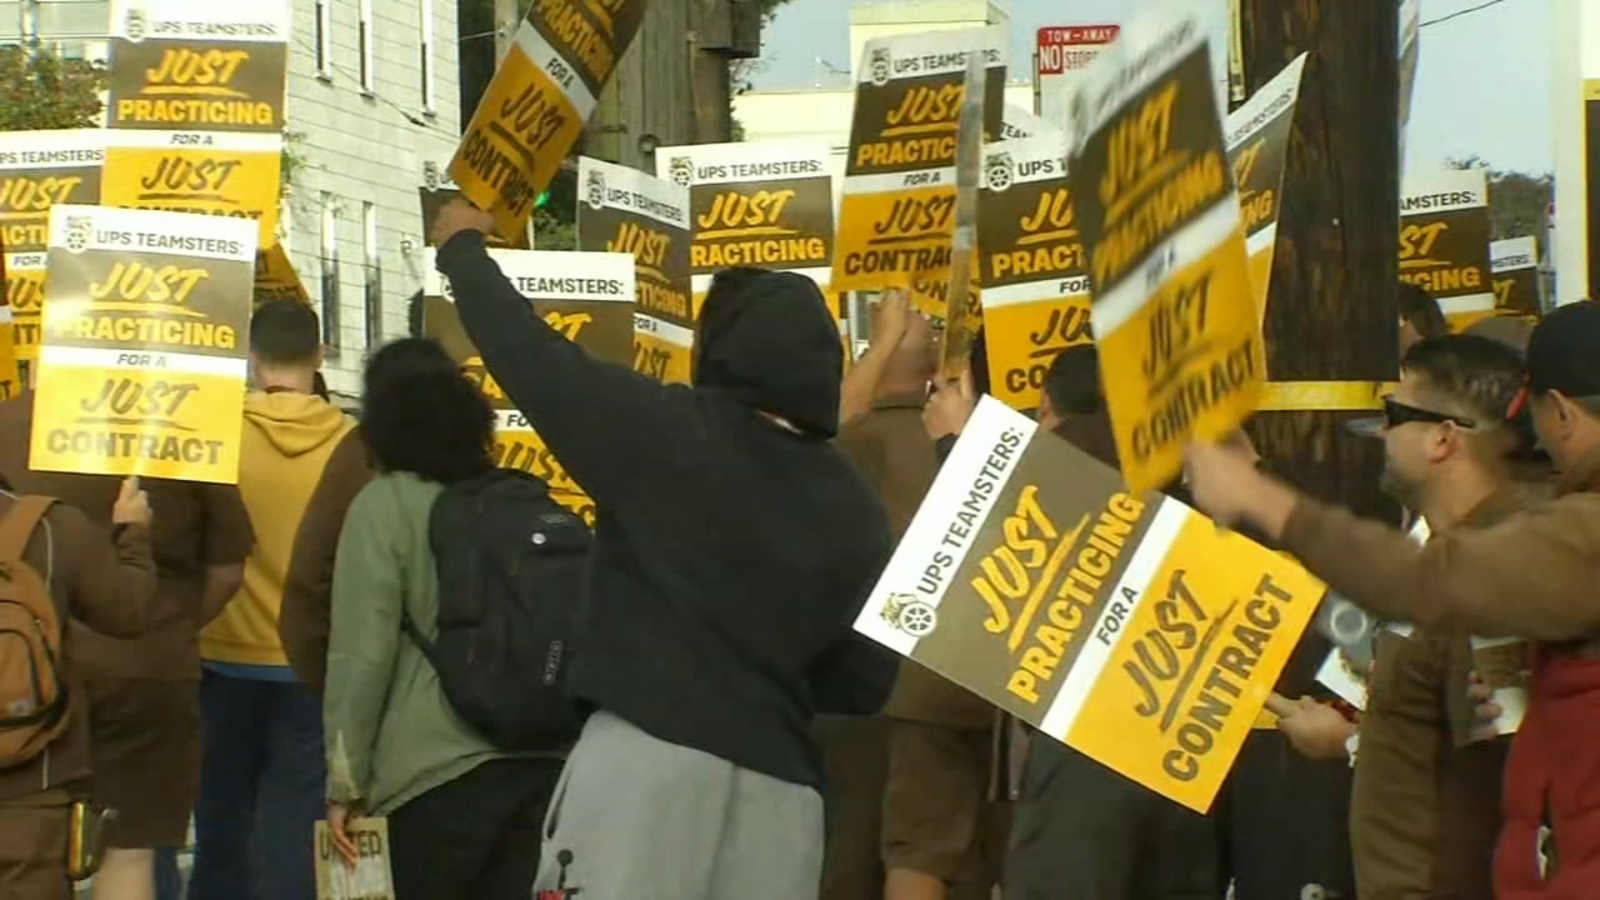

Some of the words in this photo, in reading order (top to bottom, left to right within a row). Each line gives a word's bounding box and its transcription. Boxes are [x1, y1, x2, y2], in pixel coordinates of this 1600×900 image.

[1047, 27, 1113, 42] TOW-AWAY
[147, 48, 250, 85] JUST
[894, 57, 920, 73] UPS
[1039, 45, 1061, 71] NO
[118, 100, 274, 125] PRACTICING
[501, 82, 564, 150] JUST
[887, 84, 966, 125] JUST
[170, 134, 199, 145] FOR
[203, 135, 213, 145] A
[140, 156, 242, 192] JUST
[698, 165, 727, 180] UPS
[731, 160, 823, 178] TEAMSTERS:
[904, 174, 929, 186] FOR
[933, 172, 941, 183] A
[1018, 160, 1055, 177] UPS
[607, 188, 631, 205] UPS
[697, 189, 796, 229] JUST
[874, 195, 956, 234] JUST
[97, 230, 131, 246] UPS
[138, 232, 245, 255] TEAMSTERS:
[607, 222, 670, 266] JUST
[14, 256, 41, 266] FOR
[90, 262, 209, 302] JUST
[519, 277, 625, 295] TEAMSTERS:
[117, 353, 150, 367] FOR
[80, 379, 199, 417] JUST
[47, 429, 224, 465] CONTRACT
[916, 554, 955, 595] UPS
[942, 427, 1025, 549] TEAMSTERS:
[970, 485, 1058, 635] JUST
[1006, 491, 1146, 705] PRACTICING
[1096, 601, 1128, 646] FOR
[1118, 585, 1139, 606] A
[1121, 569, 1208, 718] JUST
[1162, 573, 1294, 782] CONTRACT
